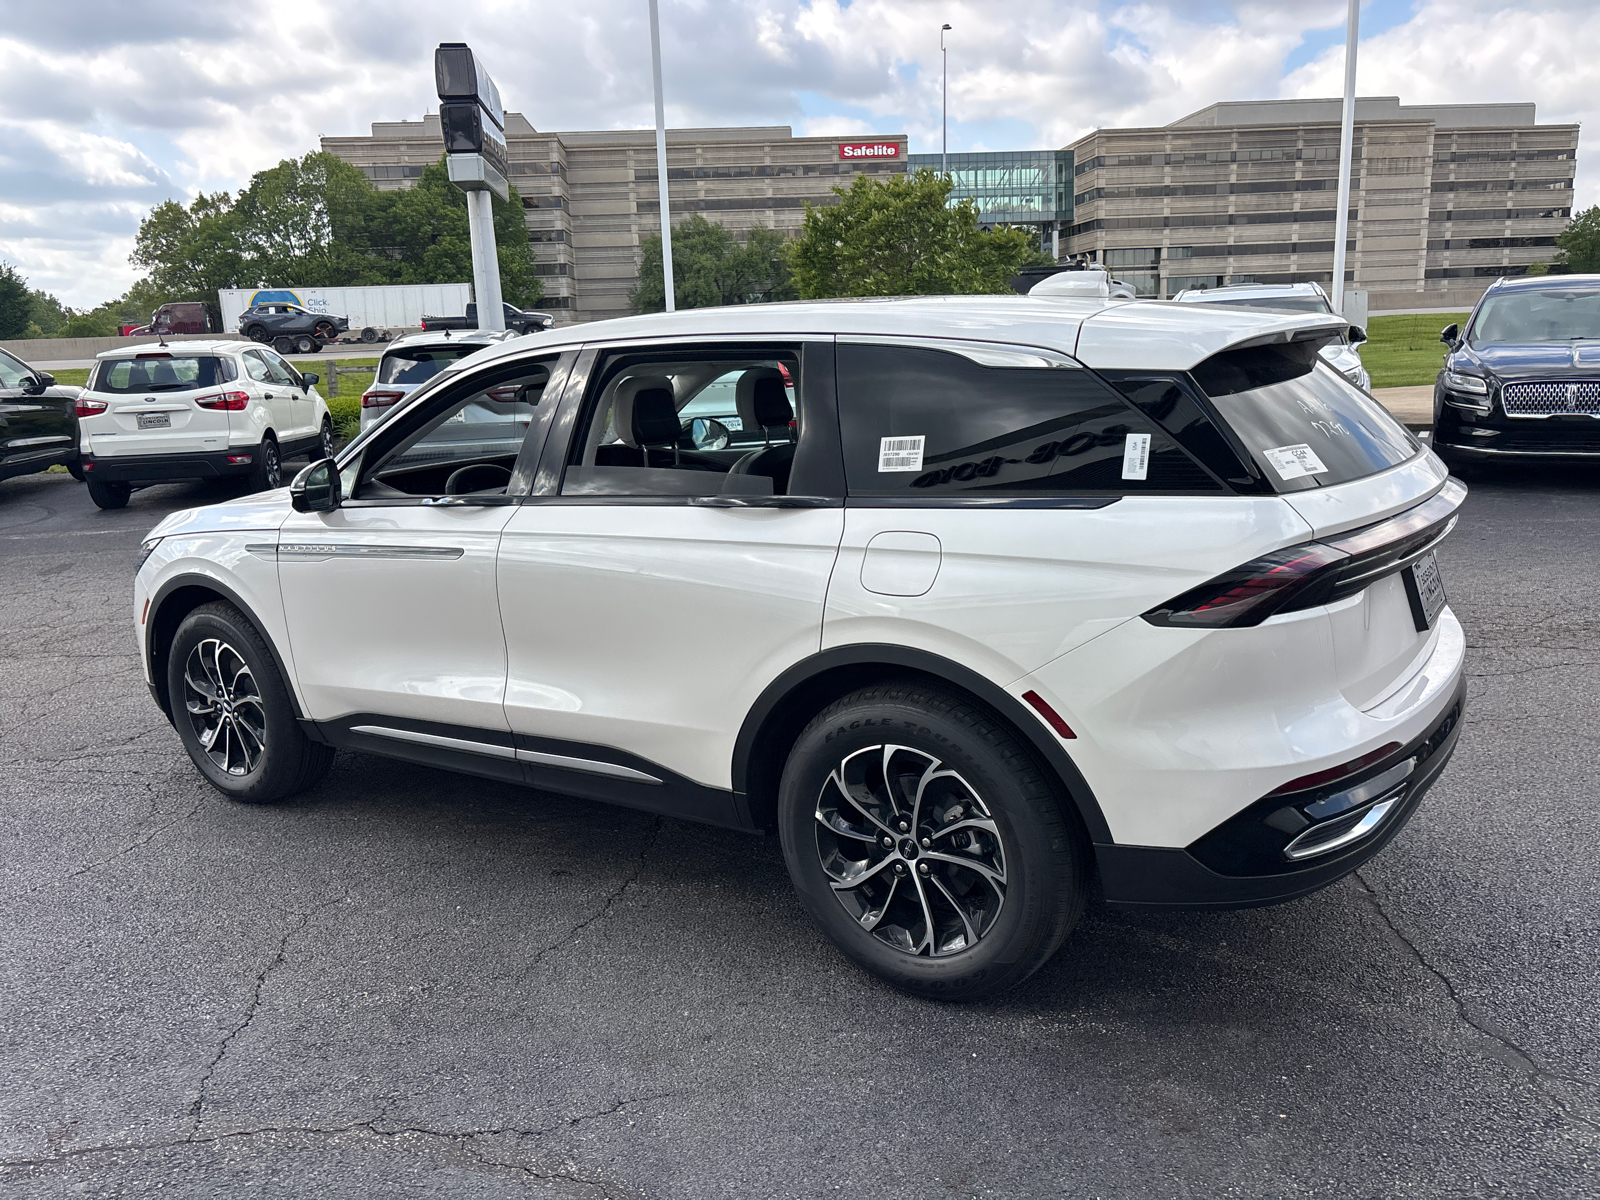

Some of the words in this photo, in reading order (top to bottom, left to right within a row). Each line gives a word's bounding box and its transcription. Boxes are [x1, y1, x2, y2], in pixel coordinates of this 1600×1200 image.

[843, 145, 896, 157] Safelite
[307, 298, 330, 306] Click.
[824, 717, 893, 744] EAGLE
